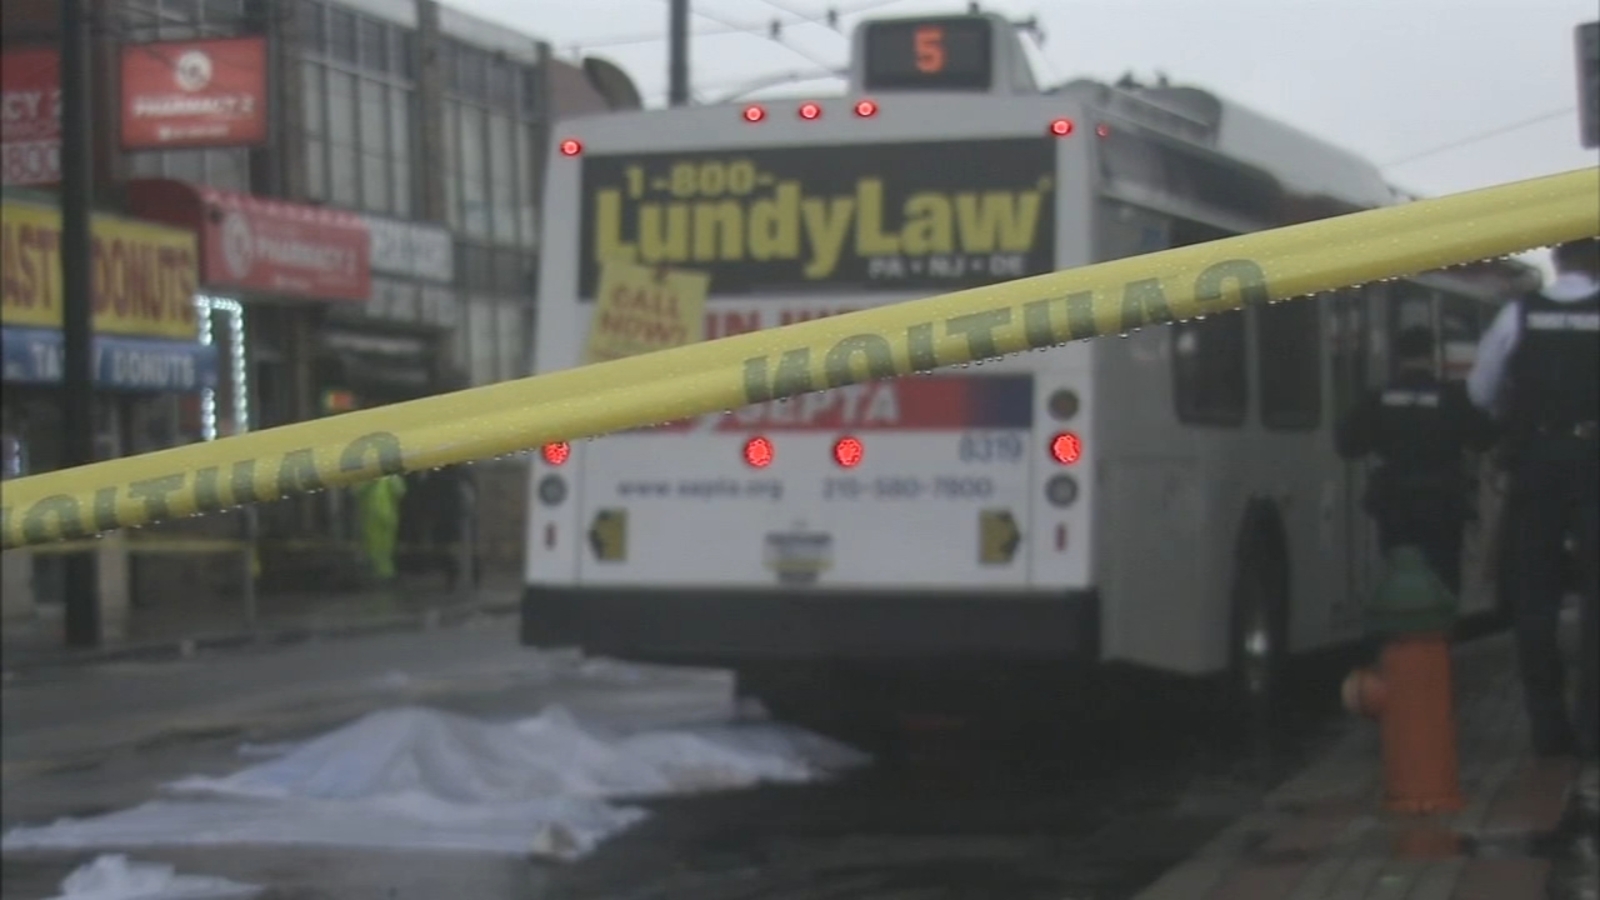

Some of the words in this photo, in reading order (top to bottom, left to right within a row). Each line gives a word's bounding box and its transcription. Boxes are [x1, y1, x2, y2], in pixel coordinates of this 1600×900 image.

[914, 28, 946, 73] 5
[624, 161, 776, 199] 1-800-
[595, 178, 1042, 279] LundyLaw
[92, 238, 196, 325] DONUTS
[868, 258, 903, 278] PA
[929, 256, 968, 276] NJ
[989, 253, 1027, 274] DE
